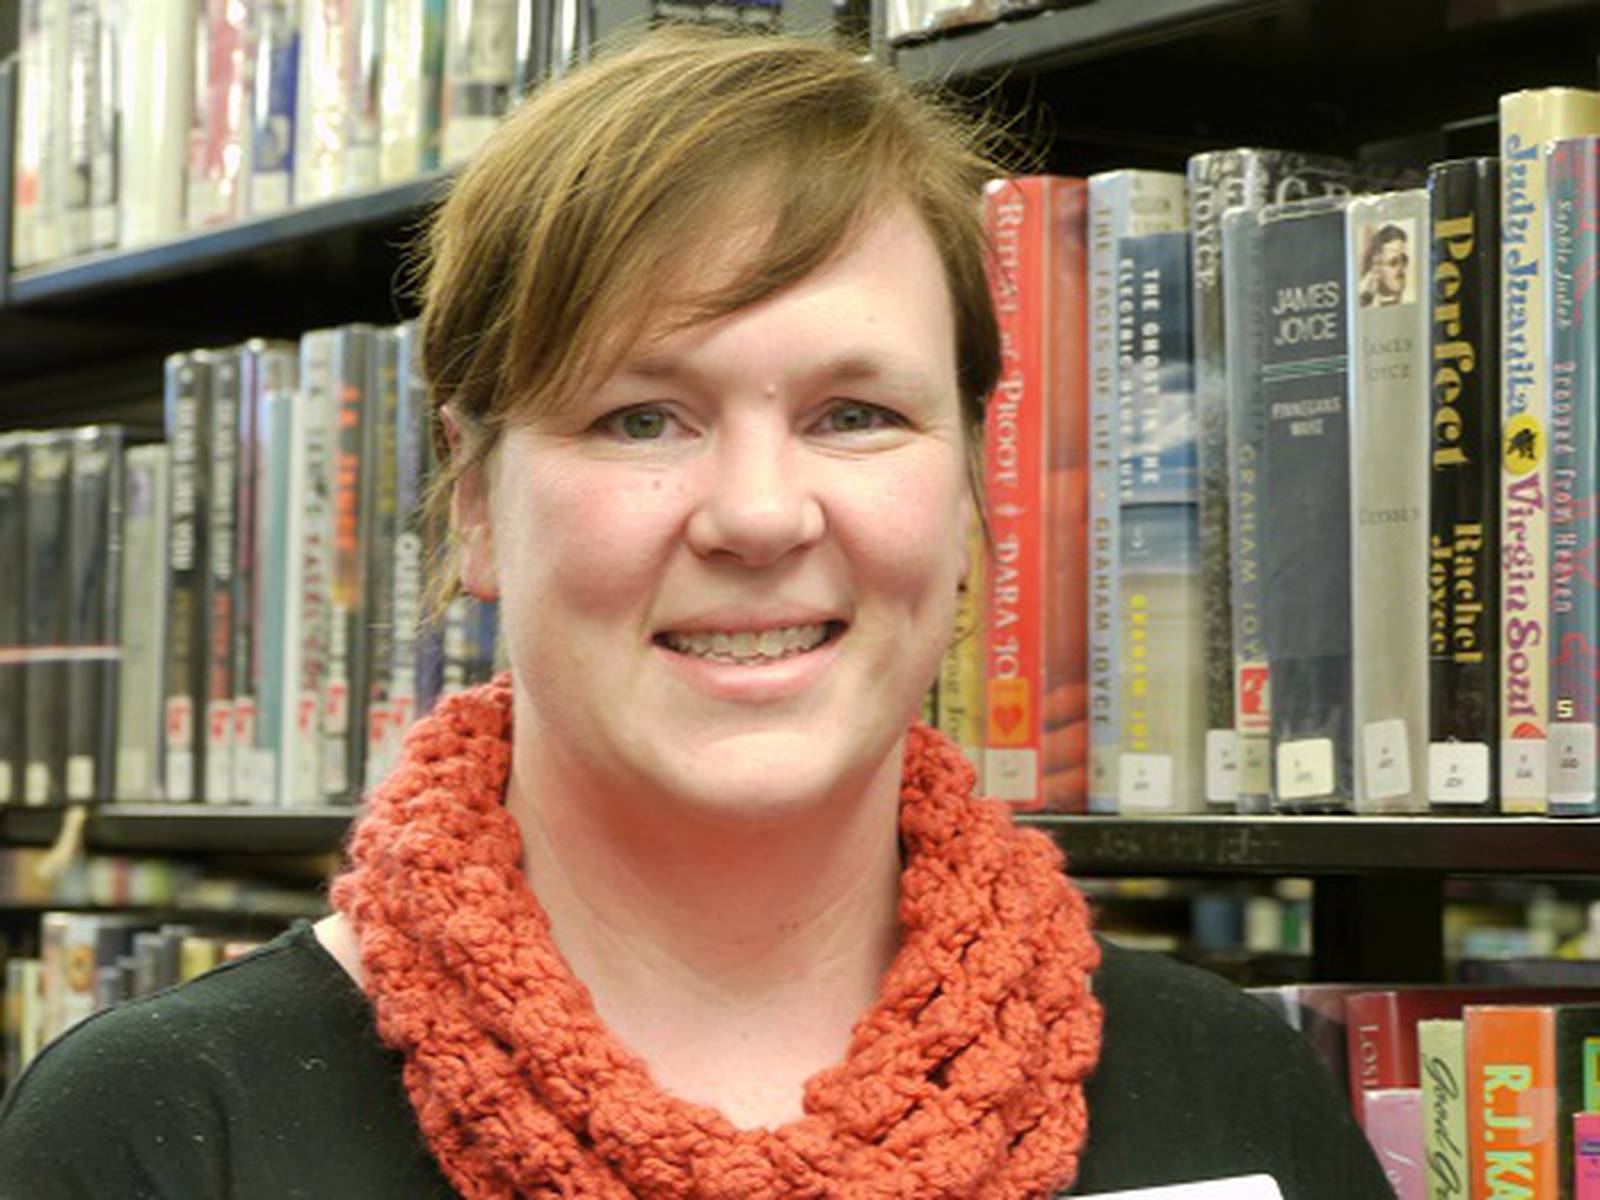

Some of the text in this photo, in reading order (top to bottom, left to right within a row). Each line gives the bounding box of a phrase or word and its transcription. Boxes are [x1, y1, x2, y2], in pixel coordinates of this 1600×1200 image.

[1503, 134, 1538, 244] Judy
[1141, 269, 1160, 310] THE
[1272, 281, 1341, 316] JAMES
[1273, 312, 1338, 346] JOYCE
[1434, 212, 1475, 470] Perfect
[1141, 322, 1160, 396] GHOST
[1431, 535, 1453, 652] Joyce
[1454, 524, 1483, 663] Rachel
[1505, 473, 1543, 612] Virgin
[1507, 617, 1542, 717] Soul
